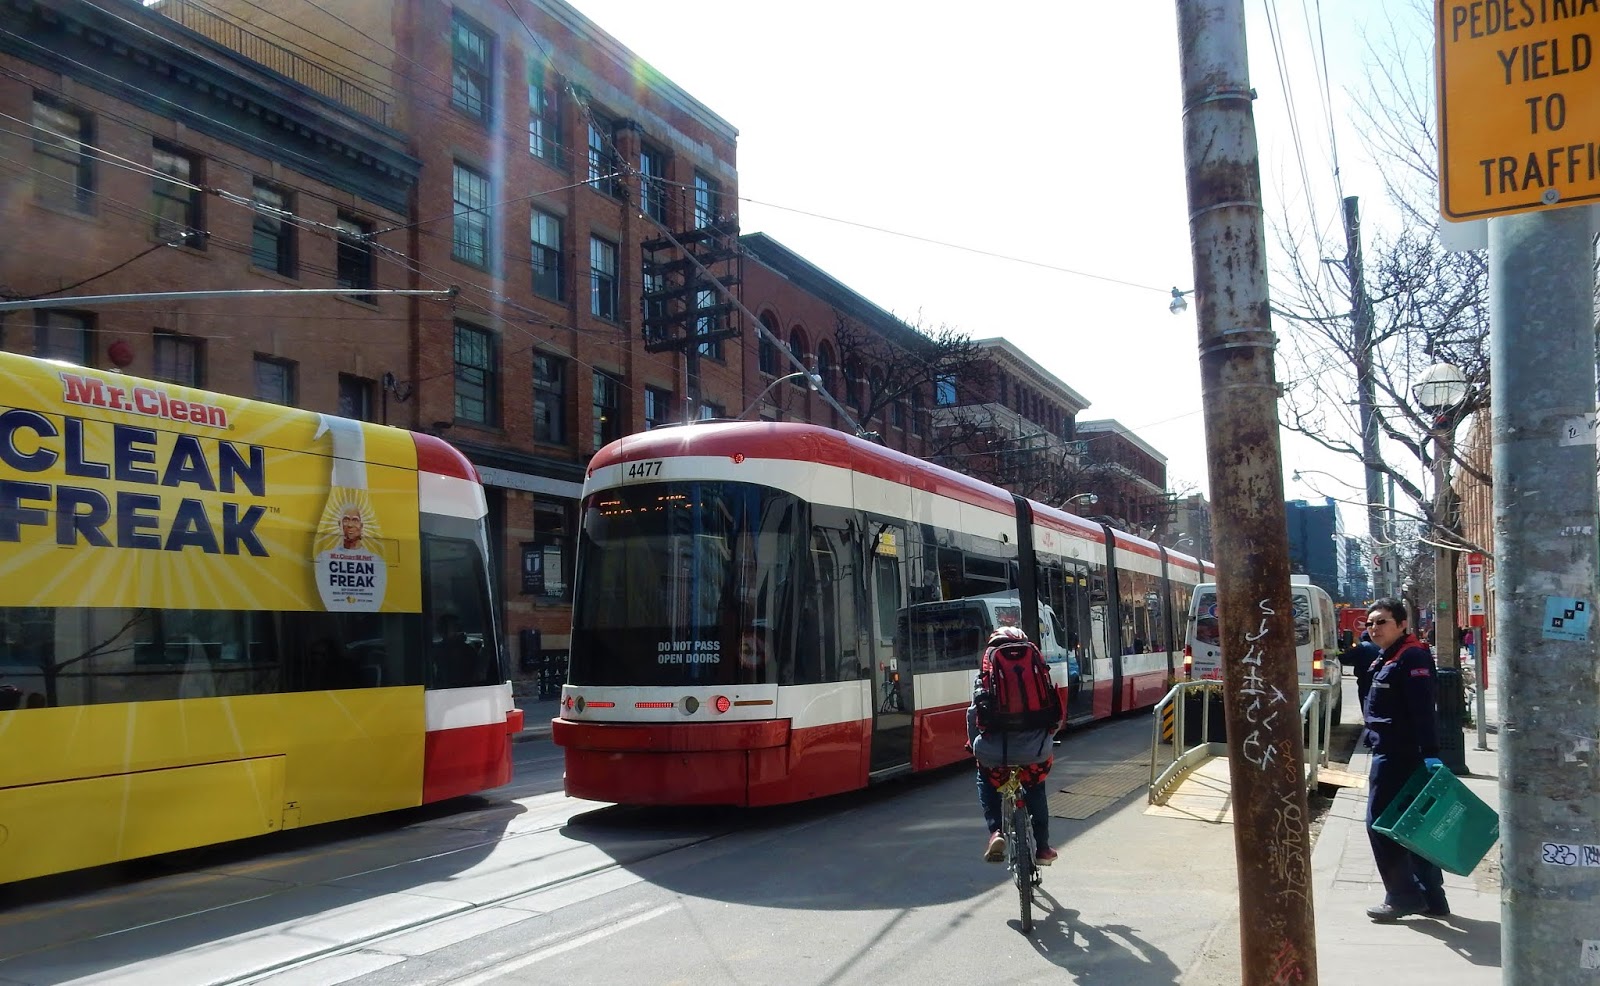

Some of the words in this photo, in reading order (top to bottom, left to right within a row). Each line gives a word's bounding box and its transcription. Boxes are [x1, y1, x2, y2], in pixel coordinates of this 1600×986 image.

[1497, 33, 1592, 85] YIELD
[1525, 93, 1566, 135] TO
[1480, 142, 1600, 196] TRAFFI
[0, 408, 266, 497] CLEAN
[629, 461, 662, 478] 4477
[0, 479, 270, 557] FREAK
[329, 561, 375, 575] CLEAN
[330, 574, 375, 588] FREAK
[658, 641, 671, 651] DO
[673, 641, 692, 651] NOT
[694, 640, 720, 651] PASS
[658, 654, 683, 664] OPEN
[686, 653, 720, 664] DOORS
